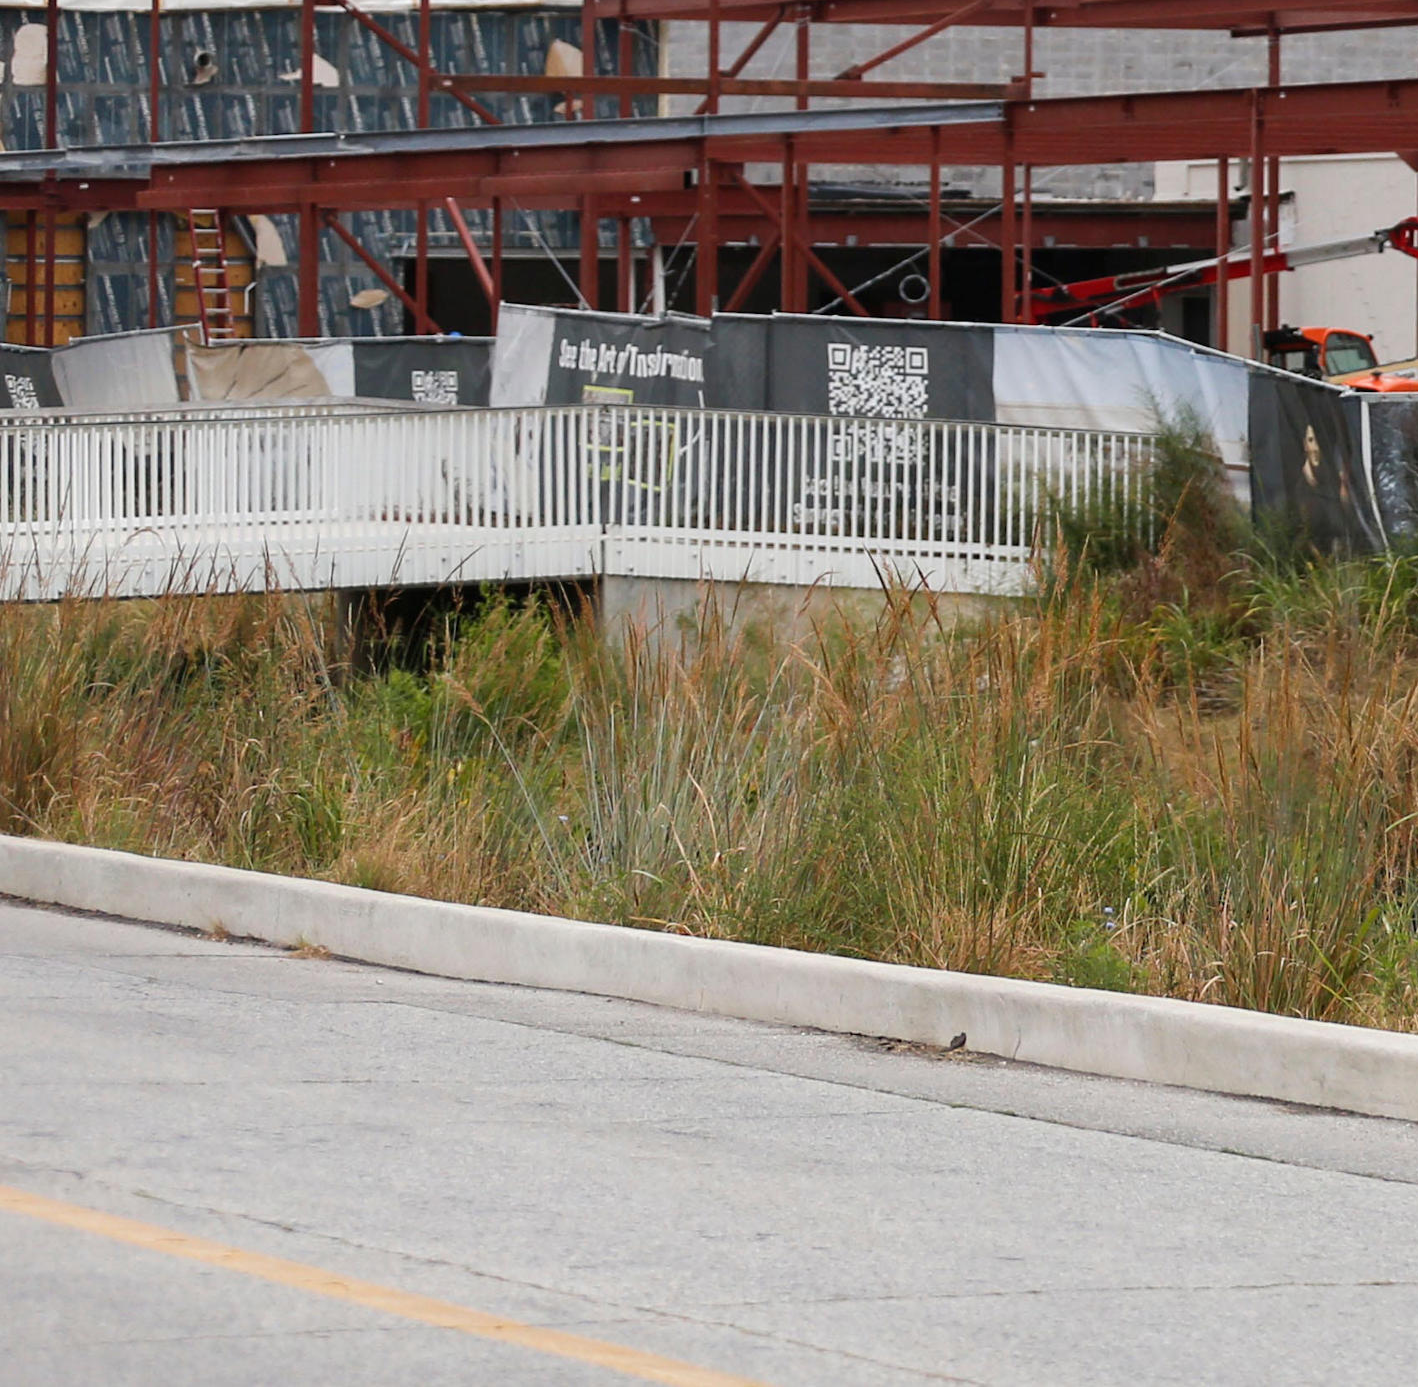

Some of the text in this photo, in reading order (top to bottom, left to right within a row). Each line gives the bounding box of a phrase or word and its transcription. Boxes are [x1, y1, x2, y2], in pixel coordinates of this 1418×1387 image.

[558, 337, 578, 370] See
[578, 338, 598, 372] the
[597, 342, 618, 374] Art
